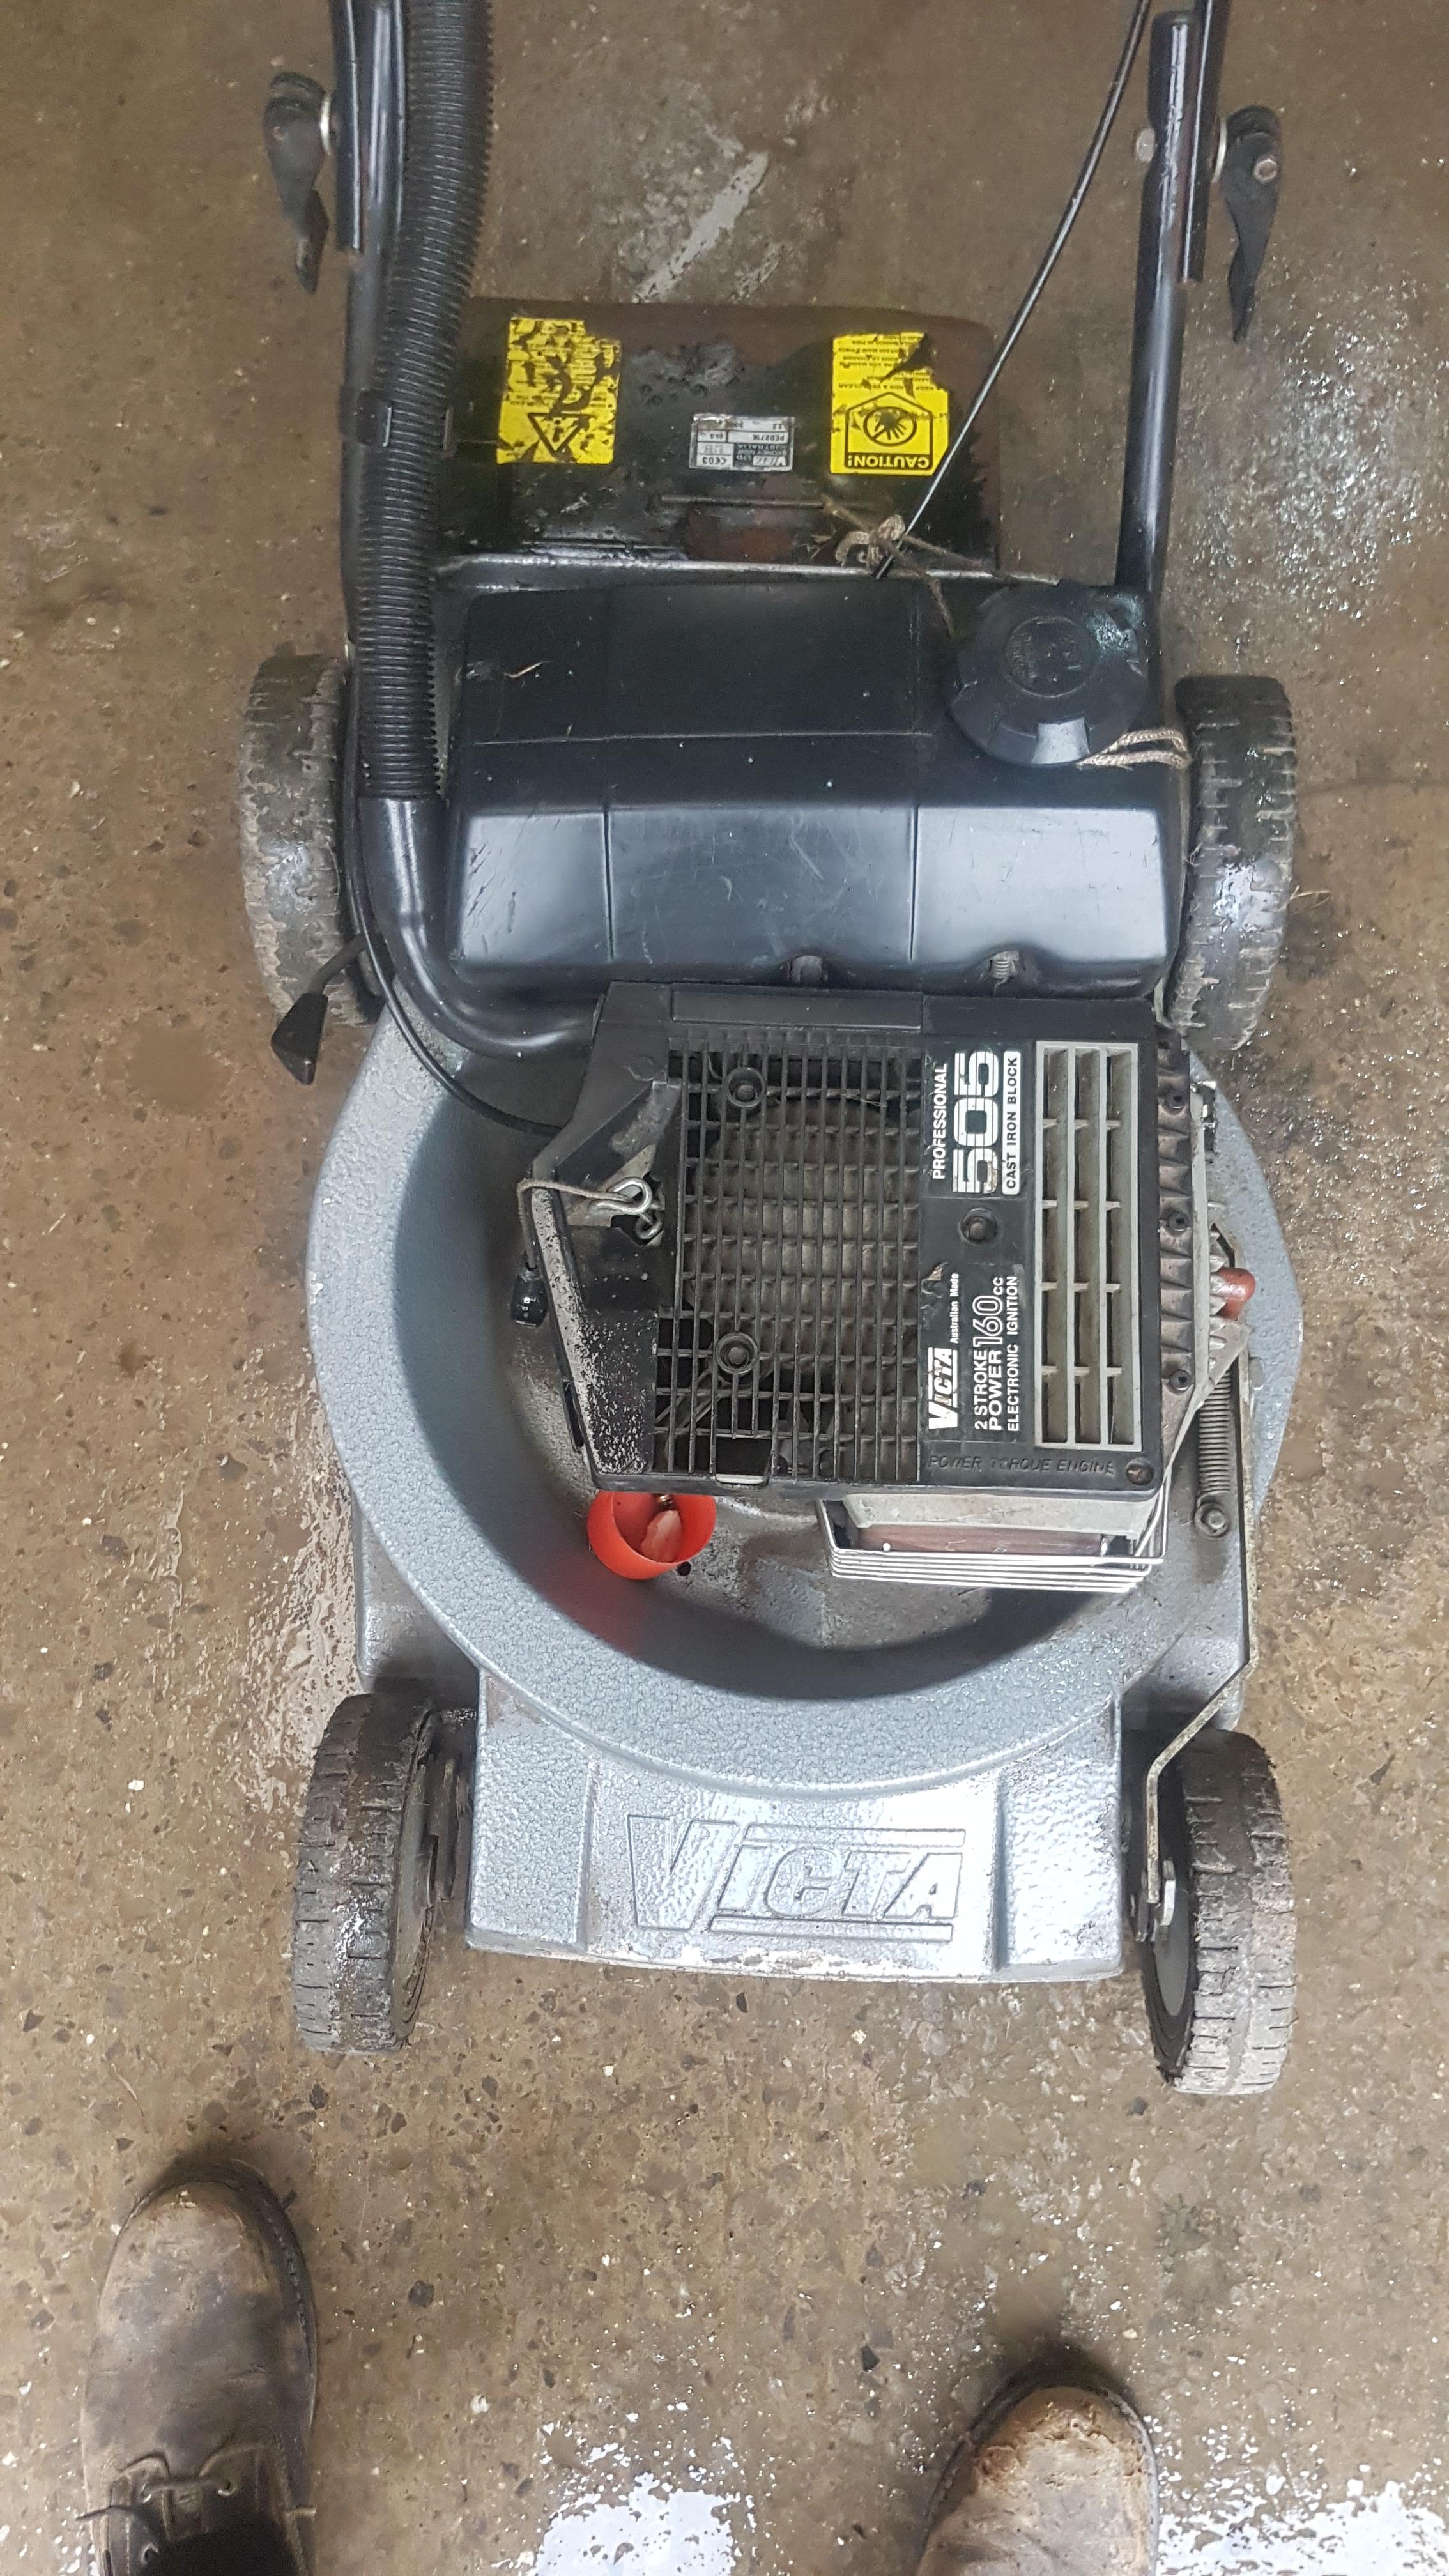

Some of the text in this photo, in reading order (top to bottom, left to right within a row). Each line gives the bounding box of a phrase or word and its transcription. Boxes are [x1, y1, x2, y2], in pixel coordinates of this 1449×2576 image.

[847, 456, 930, 468] CAUTION!
[932, 1064, 947, 1179] PROFESSIONAL
[953, 1051, 999, 1194] 505
[1006, 1057, 1018, 1189] CAST IRON BLOCK
[949, 1273, 959, 1344] Australian Made
[1006, 1276, 1020, 1432] ELECTRONIC IGNITION
[928, 1347, 958, 1429] VICTA
[974, 1350, 989, 1430] 2 STROKE
[988, 1350, 1003, 1431] POWER
[627, 1814, 966, 1941] VICTA
